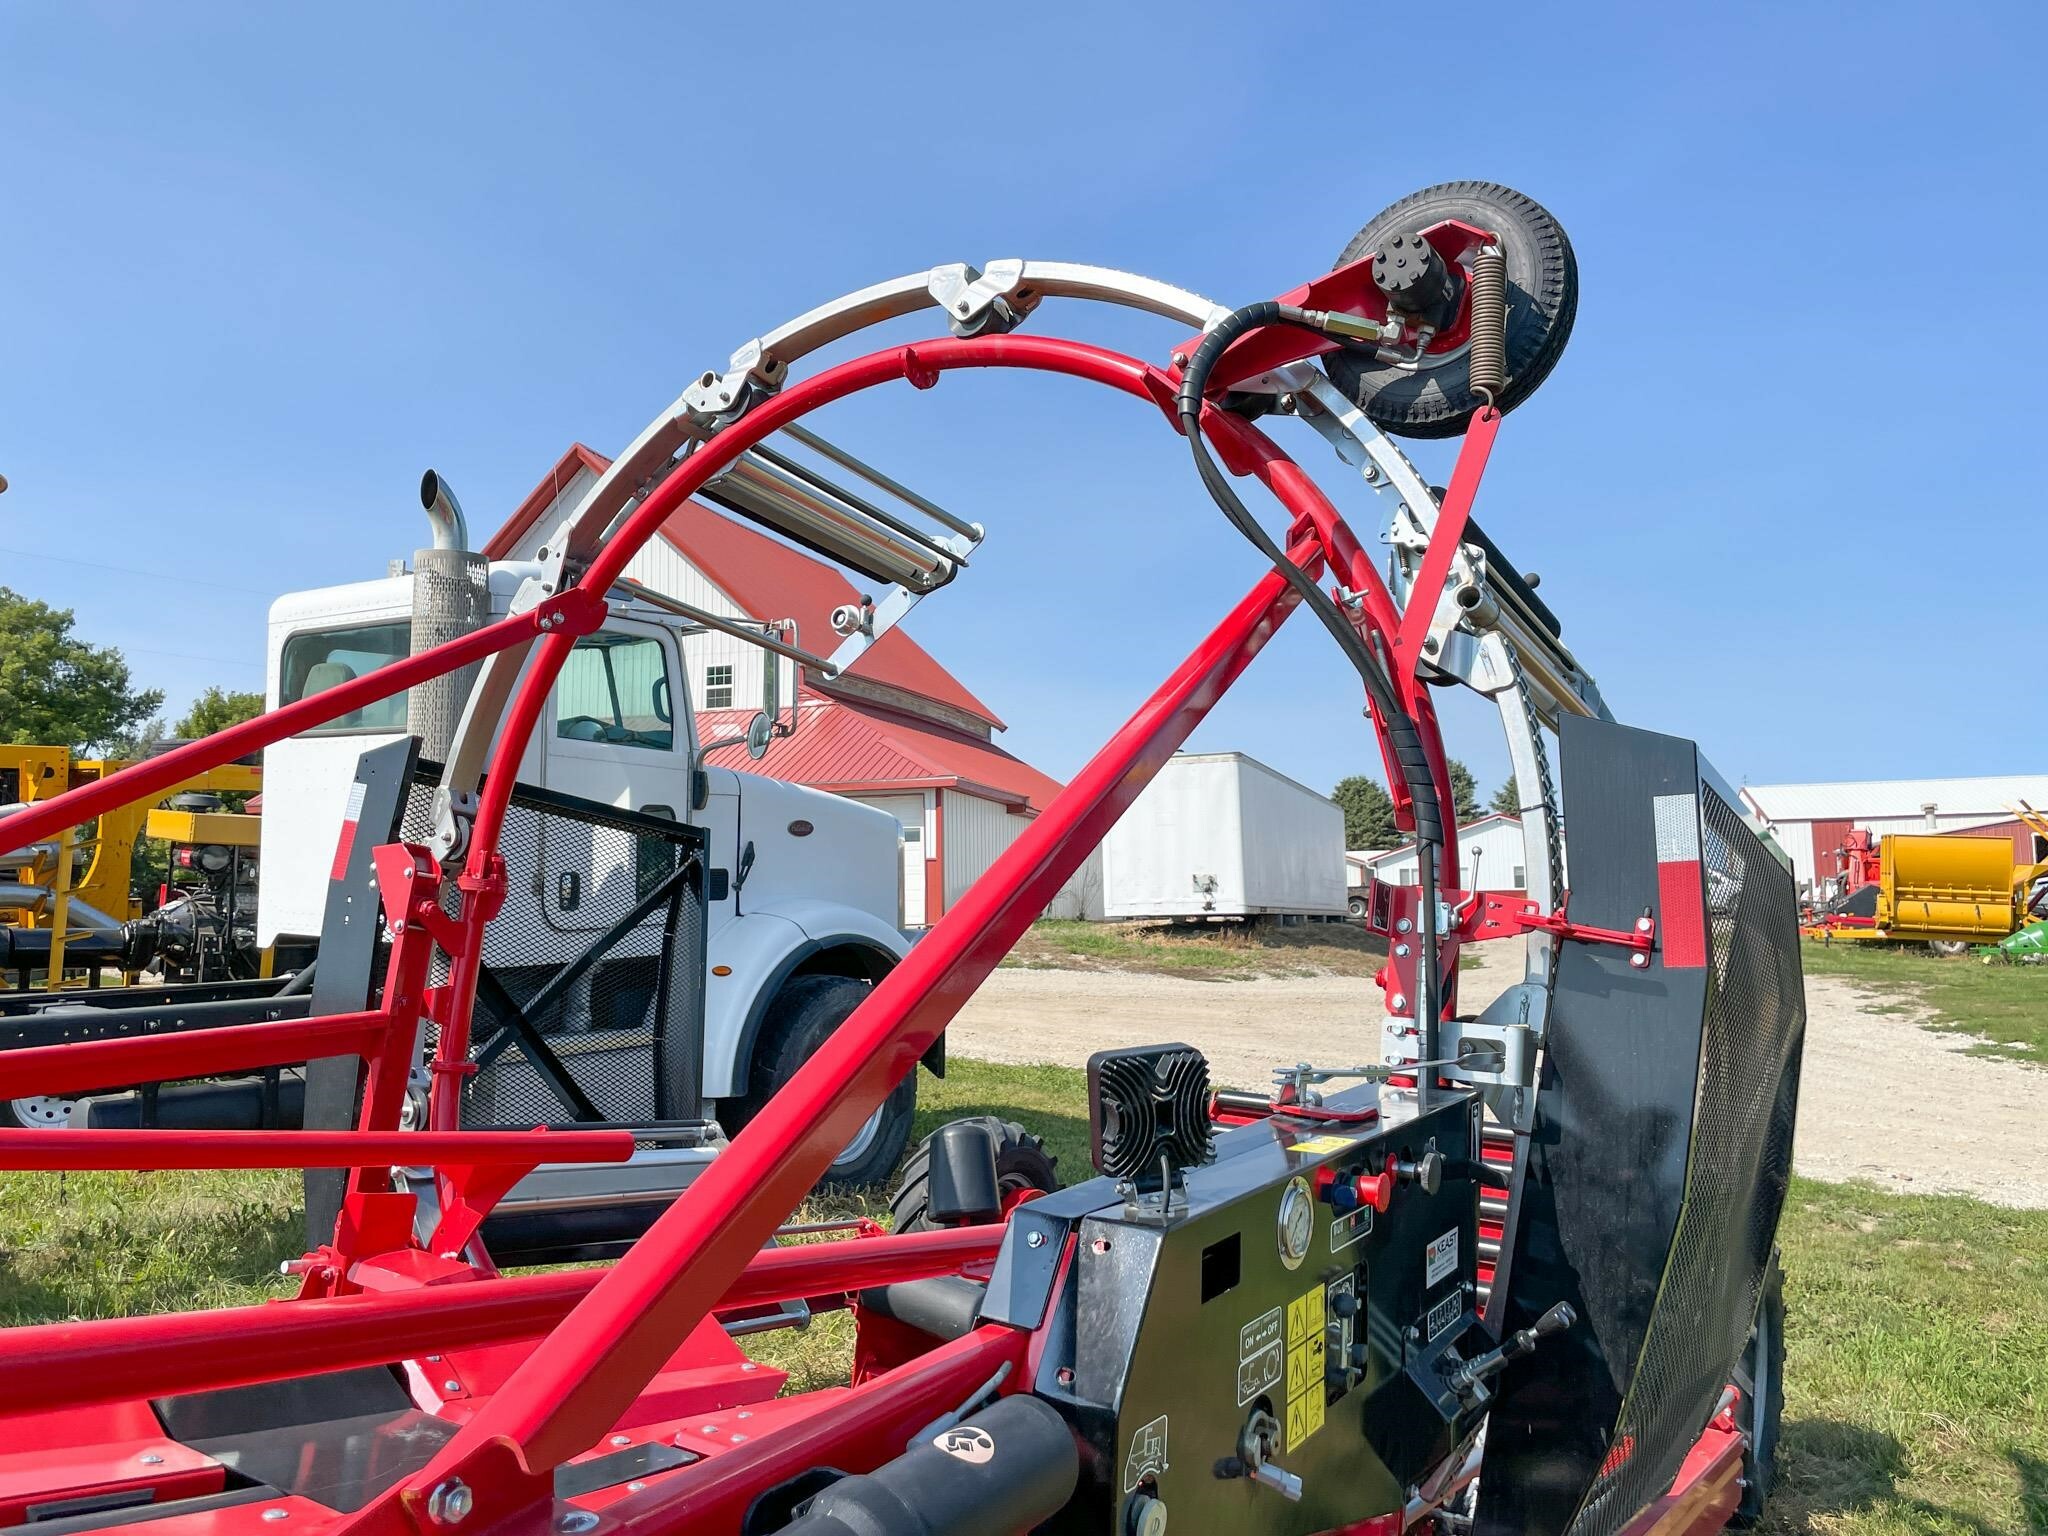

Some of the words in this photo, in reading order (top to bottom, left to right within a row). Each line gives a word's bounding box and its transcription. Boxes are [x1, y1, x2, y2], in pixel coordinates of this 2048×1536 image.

[1437, 1232, 1457, 1253] KEAST
[1245, 1335, 1254, 1349] ON
[1267, 1320, 1278, 1335] OFF
